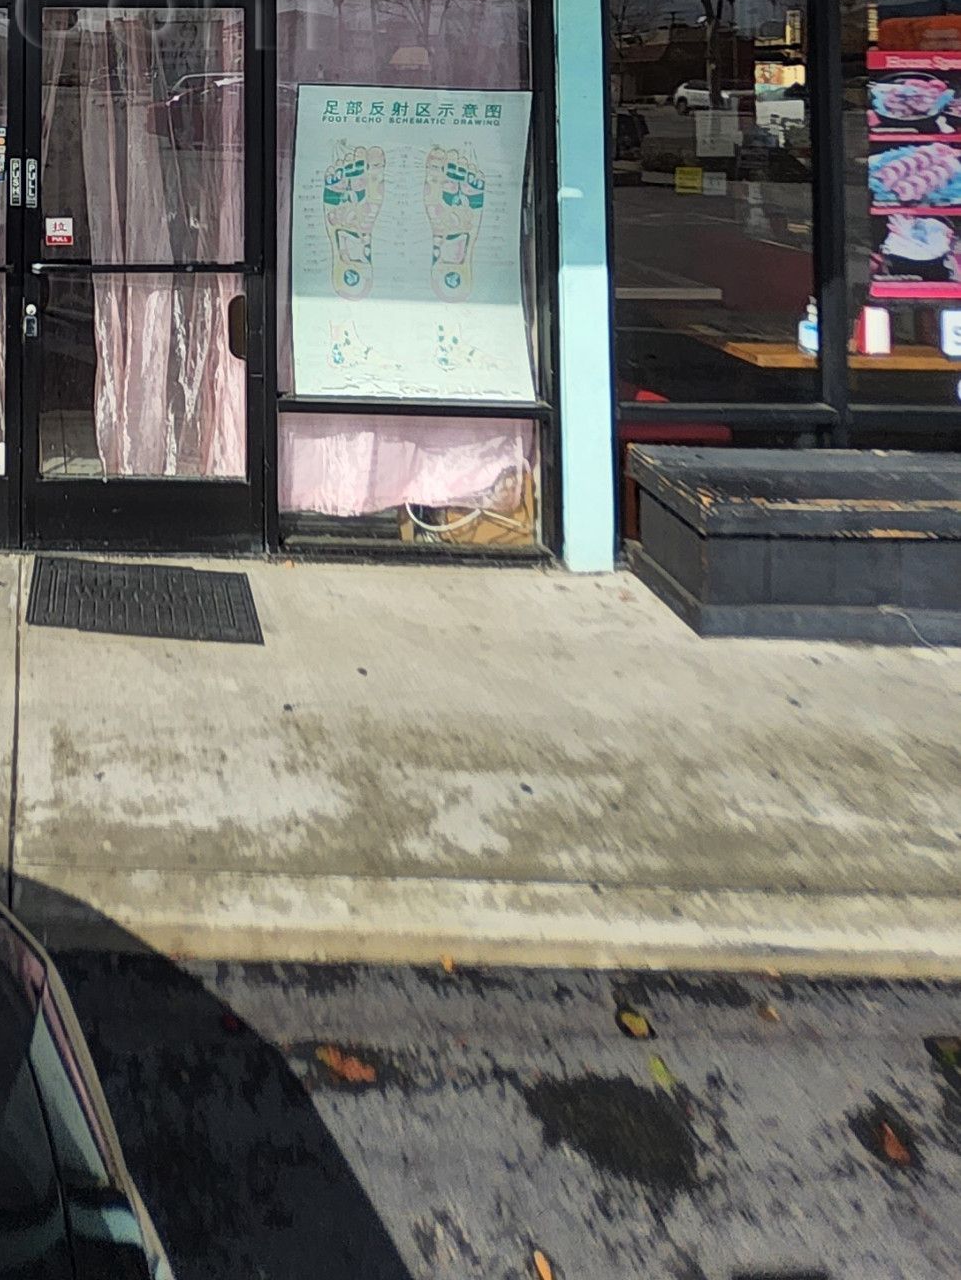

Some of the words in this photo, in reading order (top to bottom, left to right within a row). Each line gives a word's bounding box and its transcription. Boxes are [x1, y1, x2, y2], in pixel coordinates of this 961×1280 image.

[322, 115, 348, 123] FOOT
[355, 116, 382, 124] ECHO
[388, 117, 446, 125] SCHEMATIC
[453, 118, 501, 126] DRAWING
[323, 99, 503, 119] 足部反射区示意图
[11, 162, 20, 195] PUSH
[27, 164, 36, 197] PULL
